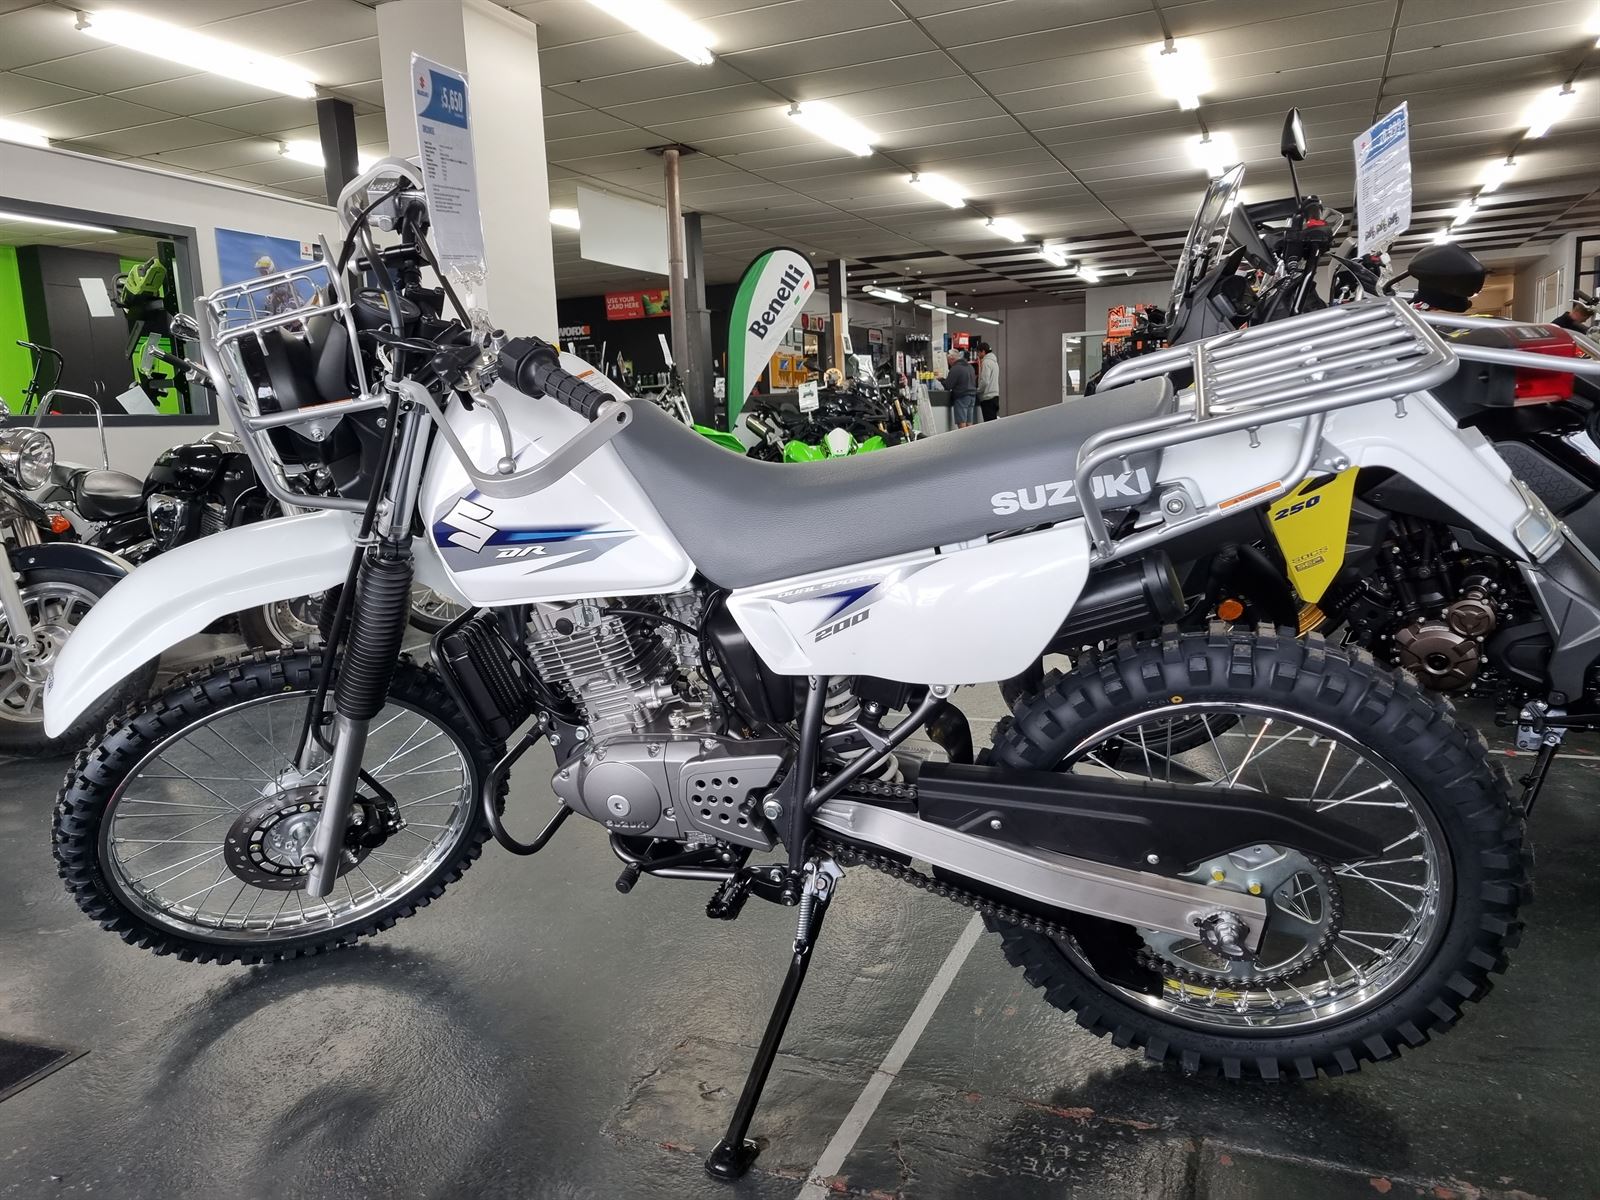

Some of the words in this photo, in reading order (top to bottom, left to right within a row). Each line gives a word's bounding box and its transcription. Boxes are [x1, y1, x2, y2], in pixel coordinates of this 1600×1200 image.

[607, 296, 618, 304] USE
[619, 295, 634, 303] YOUR
[748, 264, 804, 340] Benelli
[1273, 495, 1321, 521] 250
[495, 545, 548, 559] DR
[777, 585, 819, 599] DUAL
[814, 608, 871, 643] 200
